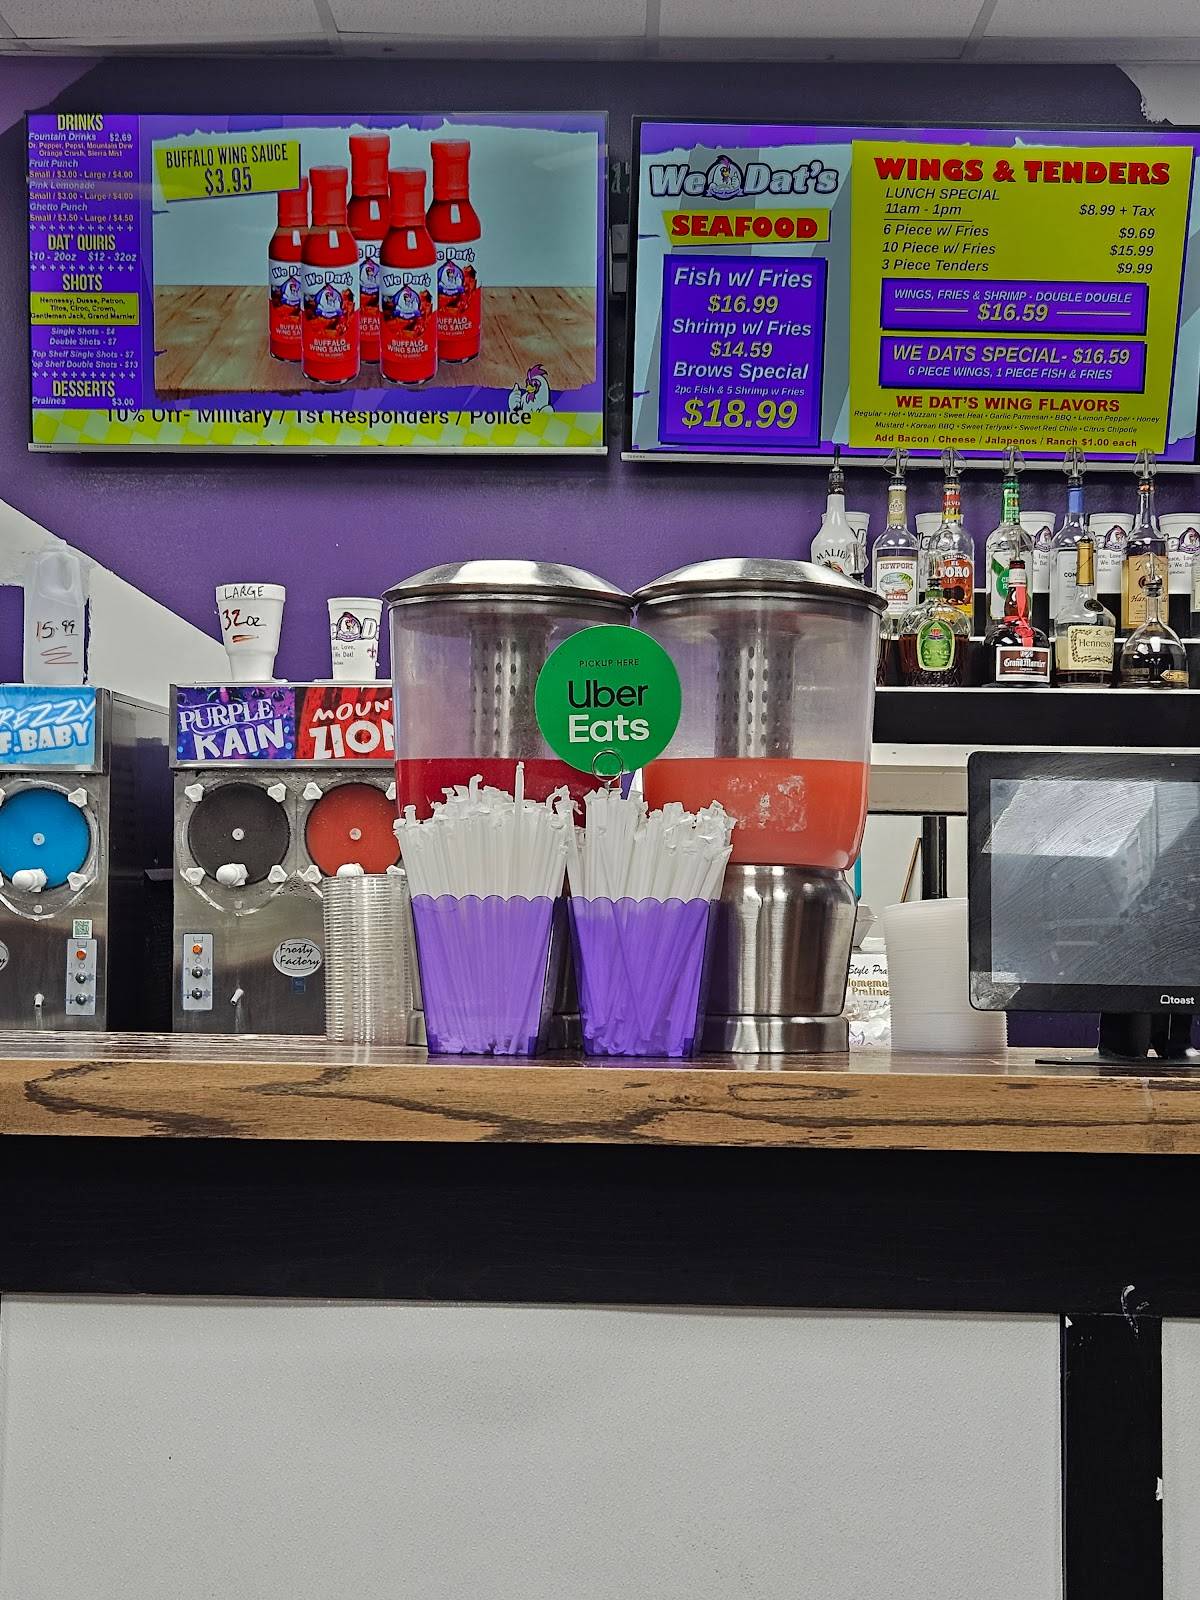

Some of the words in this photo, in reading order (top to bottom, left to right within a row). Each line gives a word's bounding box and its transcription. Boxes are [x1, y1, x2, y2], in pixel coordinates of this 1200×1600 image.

[57, 115, 104, 131] DRINKS
[28, 132, 67, 141] Fountain
[68, 132, 97, 141] Drinks
[109, 132, 132, 142] $2.69
[166, 148, 215, 169] BUFFALO
[218, 146, 248, 165] WING
[251, 143, 288, 163] SAUCE
[28, 160, 50, 168] Fruit
[50, 160, 79, 168] Punch
[873, 157, 984, 182] WINGS
[992, 159, 1017, 183] &
[1023, 160, 1171, 186] TENDERS
[29, 170, 51, 179] Small
[57, 170, 78, 179] $3.00
[84, 171, 106, 180] Large
[112, 170, 134, 179] $4.00
[204, 166, 253, 196] $3.95
[649, 164, 707, 197] We
[743, 159, 840, 195] Dat's
[29, 181, 49, 190] Pink
[50, 181, 96, 190] Lemonade
[29, 192, 51, 200] Small
[57, 192, 78, 201] $3.00
[84, 192, 107, 202] Large
[885, 187, 936, 199] LUNCH
[939, 188, 1000, 201] SPECIAL
[29, 203, 59, 211] Ghetto
[60, 203, 88, 211] Punch
[885, 202, 920, 215] 11am
[932, 203, 962, 218] 1pm
[1079, 203, 1116, 217] $8.99
[1132, 205, 1156, 217] Tax
[30, 214, 51, 222] Small
[57, 214, 78, 223] $3.50
[84, 215, 107, 224] Large
[113, 214, 134, 223] $4.50
[671, 214, 819, 239] SEAFOOD
[883, 223, 892, 235] 6
[895, 223, 933, 236] Piece
[936, 224, 953, 237] w/
[955, 224, 990, 237] Fries
[1118, 227, 1155, 240] $9.69
[47, 233, 75, 251] DAT'
[77, 234, 116, 252] QUIRIS
[882, 241, 899, 253] 10
[902, 242, 939, 254] Piece
[943, 242, 960, 254] w/
[962, 243, 997, 255] Fries
[54, 252, 77, 261] 20oz
[87, 251, 106, 262] $12
[113, 252, 137, 262] 32oz
[1109, 244, 1154, 257] $15.99
[881, 258, 890, 271] 3
[893, 259, 931, 271] Piece
[935, 259, 989, 272] Tenders
[1116, 262, 1153, 275] $9.99
[62, 273, 103, 292] SHOTS
[305, 271, 323, 287] We
[383, 271, 402, 288] We
[674, 266, 721, 287] Fish
[728, 268, 754, 288] w/
[758, 269, 813, 289] Fries
[894, 288, 935, 301] WINGS,
[937, 289, 970, 300] FRIES
[983, 290, 1027, 301] SHRIMP
[1035, 291, 1083, 303] DOUBLE
[1085, 292, 1133, 304] DOUBLE
[707, 294, 779, 314] $16.99
[977, 302, 1049, 323] $16.59
[50, 327, 76, 337] Single
[77, 328, 99, 336] Shots
[672, 318, 737, 338] Shrimp
[742, 320, 764, 336] w/
[766, 320, 812, 337] Fries
[49, 337, 78, 346] Double
[79, 338, 101, 346] Shots
[313, 338, 346, 348] BUFFALO
[391, 339, 424, 348] BUFFALO
[32, 350, 47, 360] Top
[48, 350, 69, 359] Shelf
[69, 350, 95, 360] Single
[95, 351, 118, 359] Shots
[709, 340, 773, 359] $14.59
[893, 344, 924, 361] WE
[927, 345, 977, 362] DATS
[1071, 347, 1131, 365] $16.59
[44, 360, 65, 369] Shelf
[66, 360, 94, 369] Double
[95, 361, 118, 369] Shots
[673, 361, 733, 378] Brows
[739, 363, 809, 383] Special
[908, 365, 915, 376] 6
[917, 366, 951, 377] PIECE
[953, 366, 993, 379] WINGS,
[1004, 367, 1039, 378] PIECE
[1040, 368, 1067, 379] FISH
[1079, 369, 1113, 380] FRIES
[52, 380, 116, 398] DESSERTS
[674, 385, 692, 396] 2pc
[694, 385, 715, 395] Fish
[734, 386, 769, 397] Shrimp
[781, 387, 806, 397] Fries
[32, 397, 67, 406] Pralines
[111, 398, 135, 407] $3.00
[895, 395, 923, 409] WE
[928, 395, 979, 410] DAT'S
[984, 397, 1033, 411] WING
[1038, 398, 1121, 412] FLAVORS
[107, 408, 146, 423] 10%
[331, 410, 450, 429] Responders
[470, 411, 533, 425] Police
[681, 396, 799, 430] $18.99
[854, 410, 882, 418] Regular
[1012, 413, 1049, 421] Parmesan
[1054, 414, 1072, 422] BBQ
[1104, 415, 1131, 424] Pepper
[874, 421, 905, 429] Mustard
[874, 433, 895, 443] Add
[897, 434, 930, 443] Bacon
[938, 435, 977, 444] Cheese
[985, 436, 1038, 447] Jalapenos
[1046, 437, 1078, 446] Ranch
[1081, 437, 1109, 447] $1.00
[1112, 439, 1138, 448] each
[880, 562, 914, 570] NEWPORT
[224, 585, 265, 600] LARGE
[579, 659, 614, 668] PICKUP
[616, 658, 640, 667] HERE
[568, 679, 649, 709] Uber
[0, 698, 96, 731] REZZY
[179, 698, 275, 733] PURPLE
[312, 698, 393, 723] MOUN
[568, 714, 650, 743] Eats
[192, 719, 286, 761] KAIN
[279, 943, 314, 955] Frosty
[279, 954, 321, 969] Factory
[848, 964, 869, 978] Style
[851, 987, 889, 997] Praline
[1169, 995, 1195, 1005] toast
